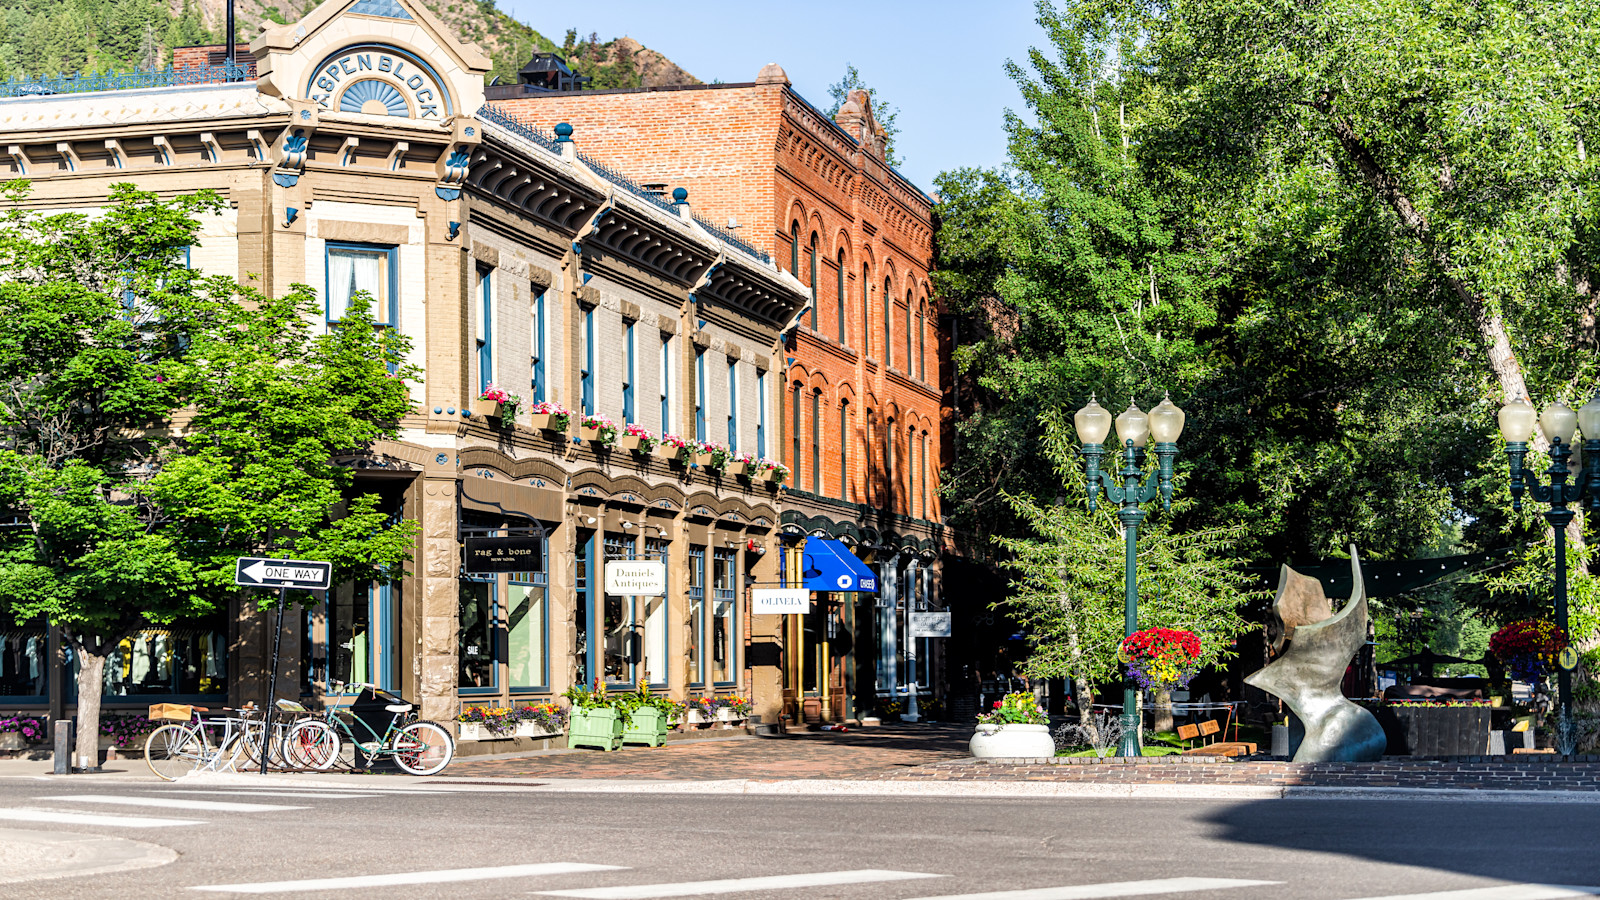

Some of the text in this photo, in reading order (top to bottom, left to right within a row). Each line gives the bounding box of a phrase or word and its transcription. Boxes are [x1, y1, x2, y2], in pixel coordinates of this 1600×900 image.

[312, 54, 438, 117] ASPEN BLOCK
[474, 549, 492, 557] rag
[265, 567, 320, 579] ONE WAY
[616, 568, 654, 577] Daniels
[612, 579, 658, 590] Antiques
[860, 579, 872, 589] CHASE
[761, 597, 802, 605] OLIVELA
[467, 645, 478, 655] SALE
